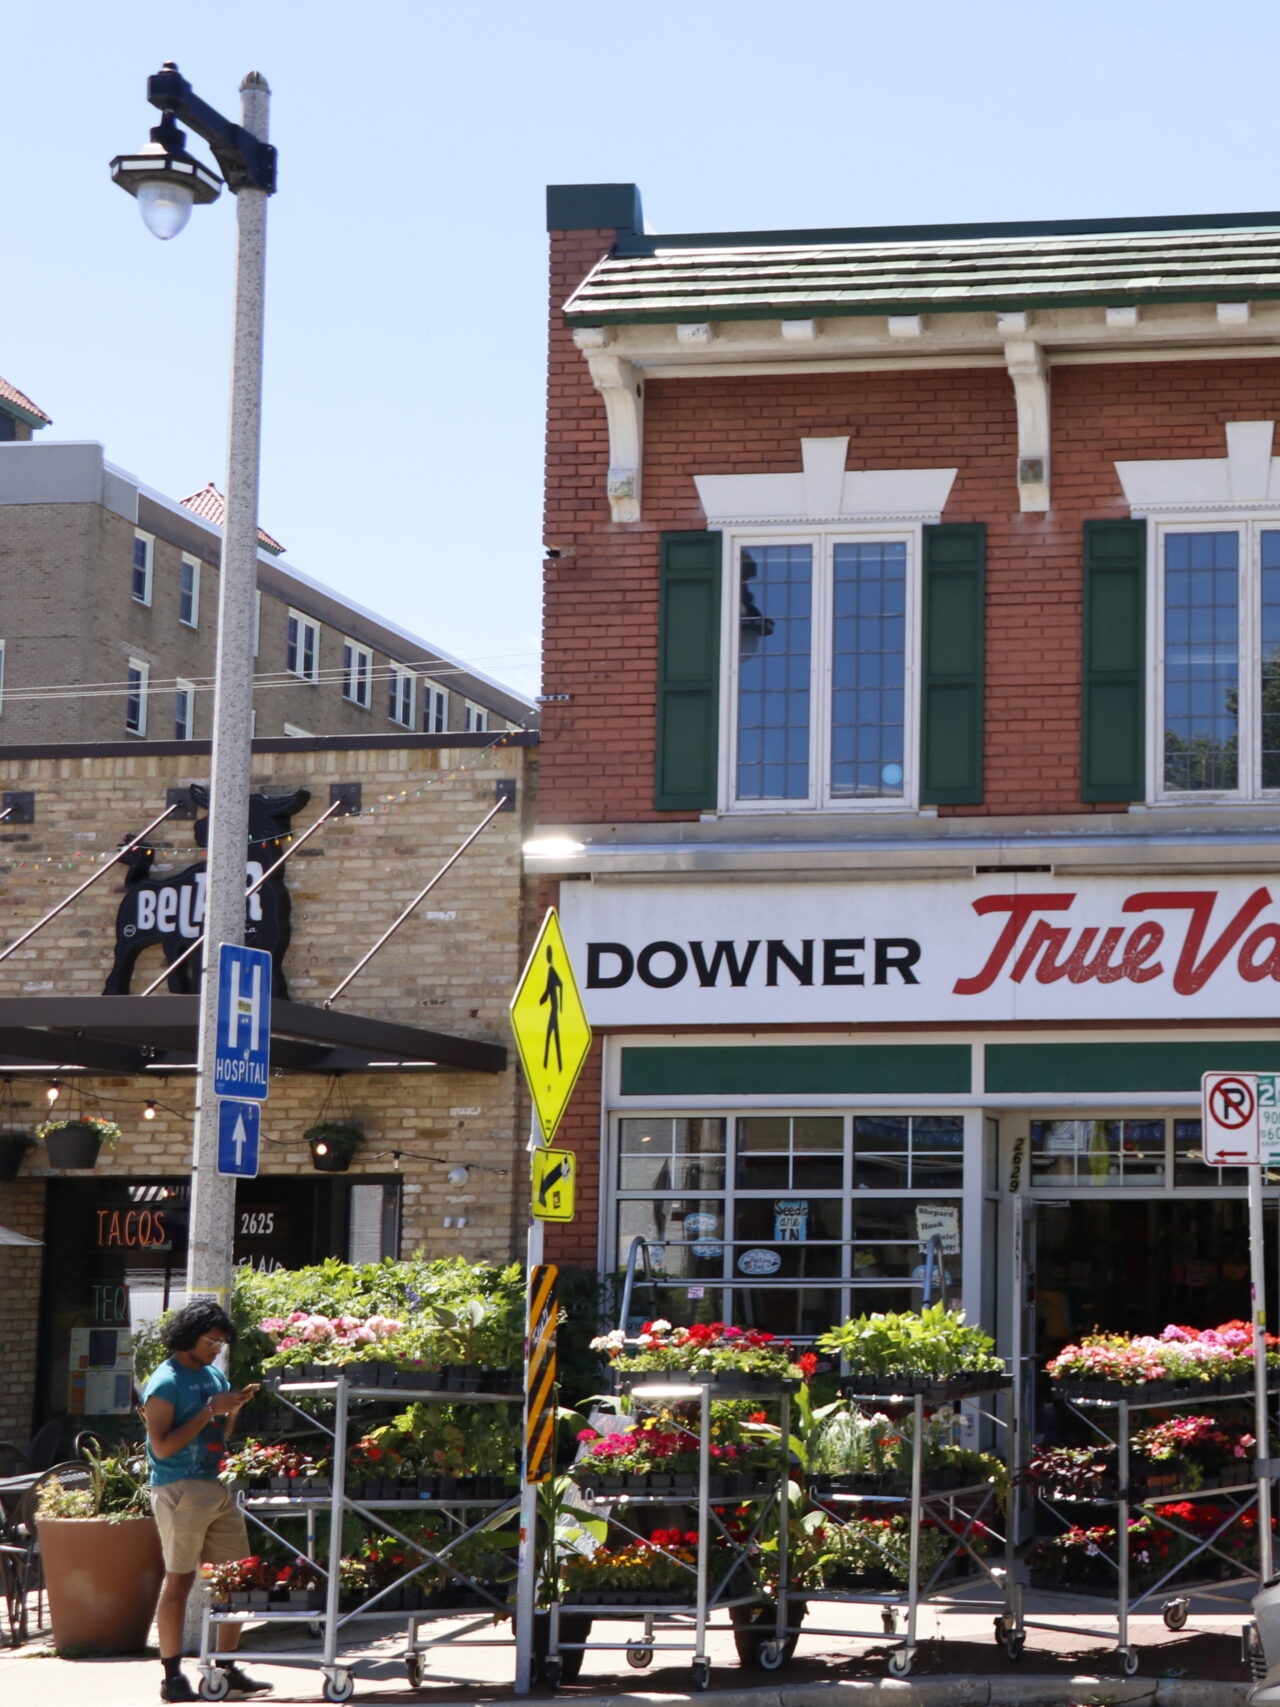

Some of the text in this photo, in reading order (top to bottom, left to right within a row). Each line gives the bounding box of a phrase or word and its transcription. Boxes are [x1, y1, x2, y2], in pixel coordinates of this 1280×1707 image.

[585, 936, 921, 989] DOWNER
[952, 892, 1165, 995] True
[229, 960, 261, 1051] H
[216, 1058, 267, 1085] HOSPITAL
[1259, 1084, 1274, 1105] 2
[774, 1200, 808, 1216] Seeds
[918, 1208, 954, 1218] Shepard
[97, 1209, 167, 1247] TACOS
[240, 1212, 275, 1235] 2625
[921, 1221, 944, 1230] Hook
